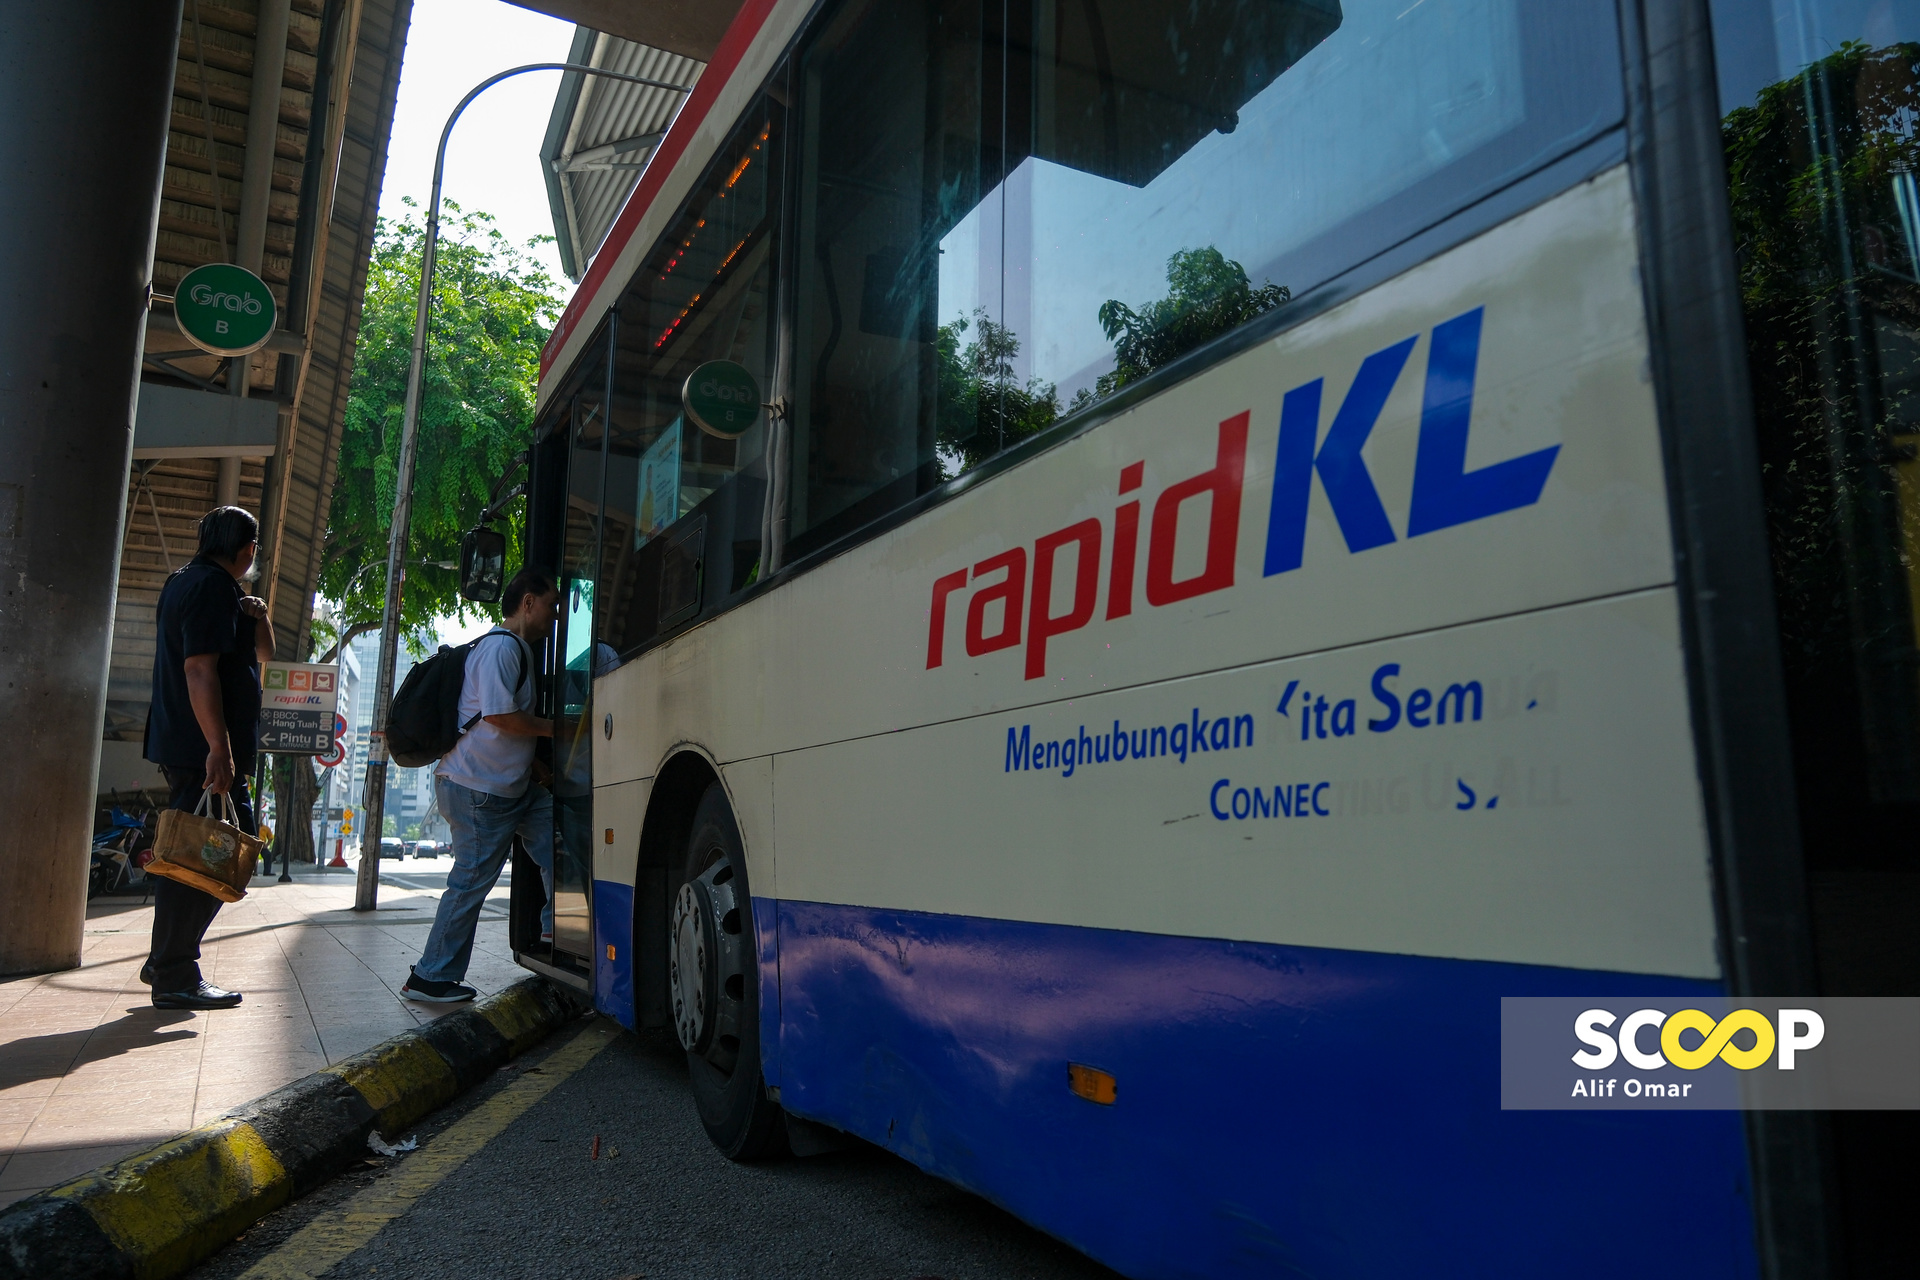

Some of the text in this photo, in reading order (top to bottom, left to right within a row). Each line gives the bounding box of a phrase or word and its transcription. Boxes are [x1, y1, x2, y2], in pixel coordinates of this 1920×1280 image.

[190, 284, 262, 315] Grab
[215, 320, 229, 334] B
[926, 304, 1563, 682] rapidKL
[274, 695, 322, 705] rapidKL
[273, 711, 299, 720] BBCC
[272, 719, 296, 729] Hang
[297, 720, 318, 729] Tuah
[279, 732, 329, 749] Pintu B
[1004, 697, 1255, 778] Menghubungkan
